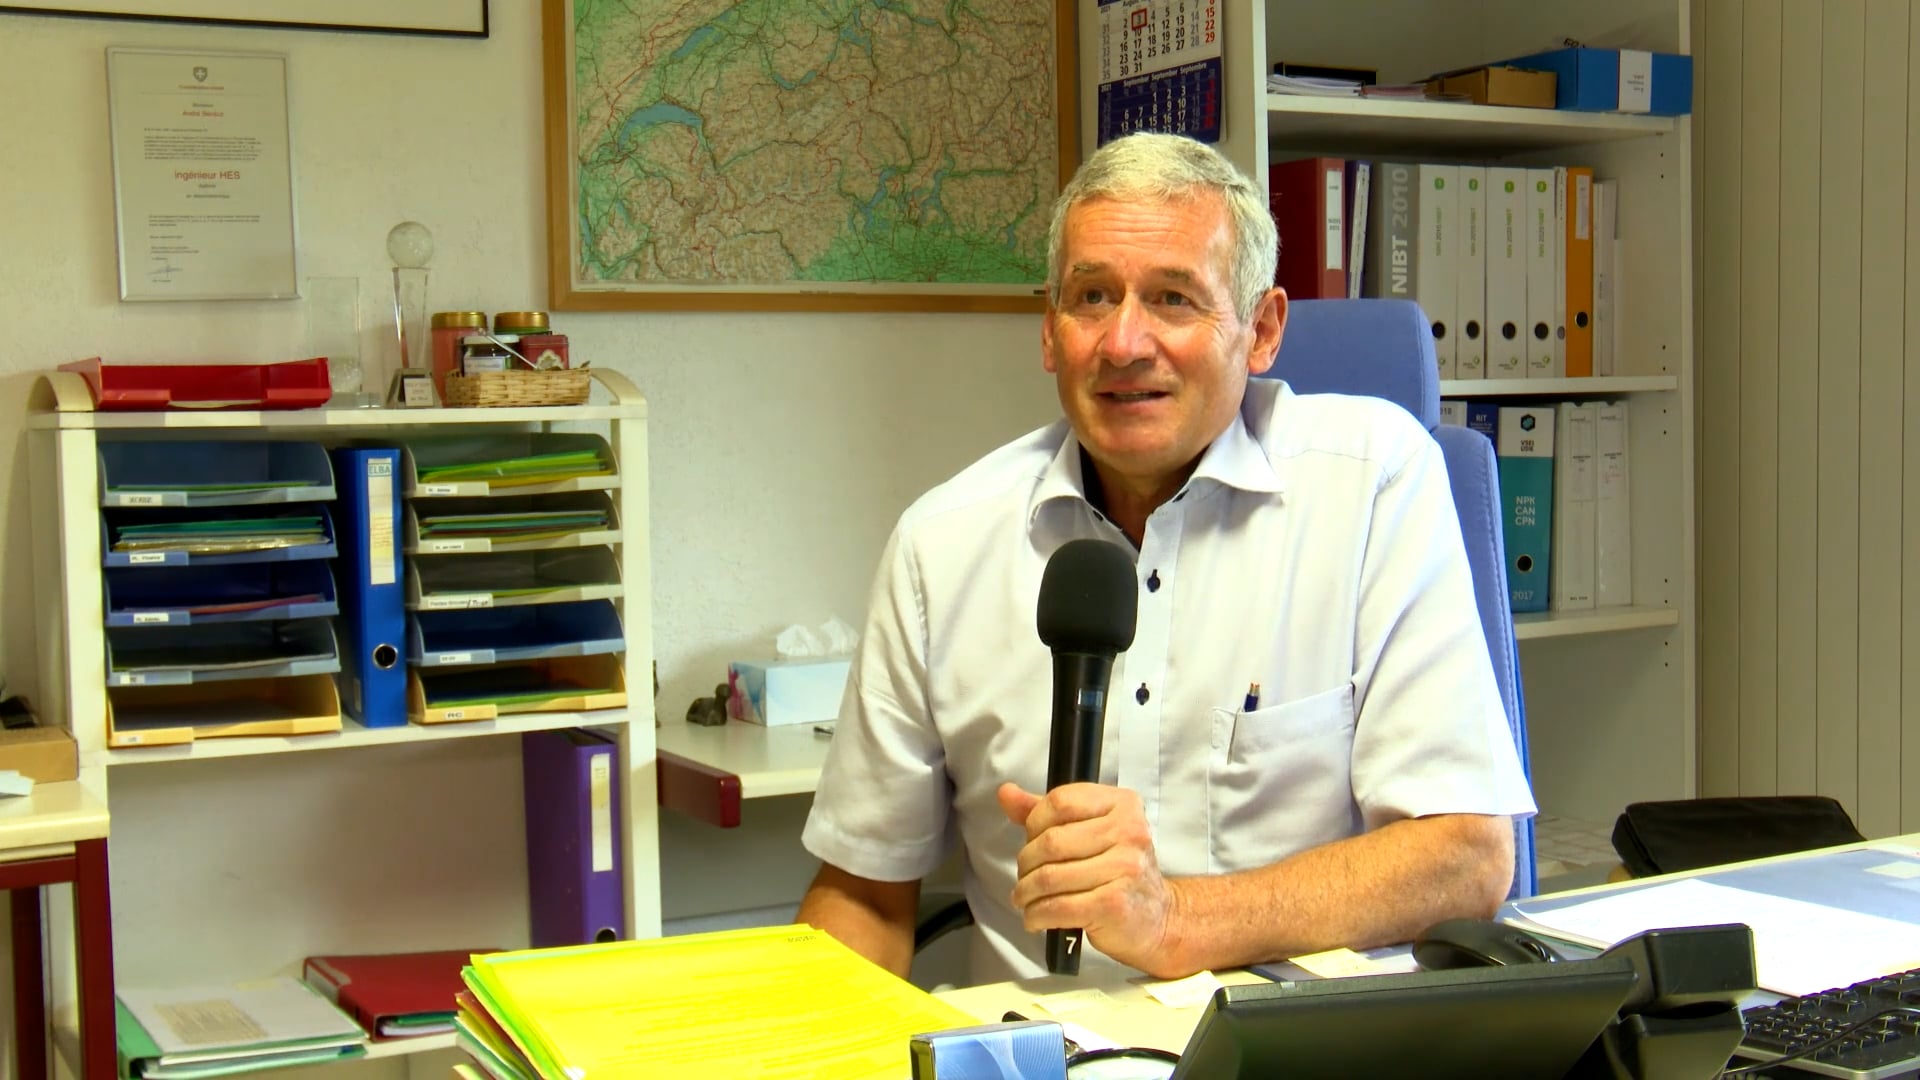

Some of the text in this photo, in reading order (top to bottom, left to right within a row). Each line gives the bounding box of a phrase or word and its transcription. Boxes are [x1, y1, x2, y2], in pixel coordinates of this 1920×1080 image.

[1123, 17, 1128, 28] 2
[1151, 9, 1156, 20] 4
[1165, 5, 1170, 17] 5
[1179, 2, 1185, 13] 6
[1123, 30, 1128, 41] 9
[1134, 27, 1141, 37] 10
[1148, 23, 1156, 34] 11
[1161, 18, 1170, 31] 12
[1175, 14, 1185, 26] 13
[1190, 10, 1200, 22] 14
[1205, 7, 1215, 18] 15
[1119, 41, 1128, 52] 16
[1133, 38, 1142, 49] 17
[1148, 34, 1156, 46] 18
[1161, 30, 1170, 42] 19
[1175, 27, 1185, 38] 20
[1190, 24, 1199, 35] 21
[1205, 19, 1215, 31] 22
[1119, 53, 1129, 64] 23
[1133, 49, 1142, 61] 24
[1147, 46, 1156, 58] 25
[1161, 43, 1170, 55] 26
[1175, 39, 1185, 51] 27
[1190, 35, 1200, 47] 28
[1205, 31, 1215, 43] 29
[1119, 65, 1129, 77] 30
[1134, 61, 1143, 73] 31
[1123, 76, 1150, 88] September
[1152, 68, 1178, 81] September
[1180, 62, 1207, 75] Septembre
[1152, 91, 1157, 103] 1
[1166, 88, 1172, 100] 2
[1180, 85, 1186, 96] 3
[1124, 109, 1130, 120] 6
[1138, 105, 1144, 118] 7
[1152, 103, 1158, 115] 8
[1166, 100, 1172, 112] 9
[1177, 97, 1187, 109] 10
[1120, 121, 1129, 133] 13
[1134, 117, 1143, 129] 14
[1148, 115, 1158, 128] 15
[1162, 112, 1172, 124] 16
[1177, 109, 1186, 121] 17
[1176, 121, 1186, 133] 24
[219, 170, 241, 180] HES
[1391, 167, 1408, 294] NIBT 2010
[368, 465, 391, 474] ELBA
[1515, 495, 1536, 505] NPK
[1514, 506, 1536, 516] CAN
[1514, 516, 1536, 526] CPN
[1512, 591, 1534, 600] 2017
[1065, 936, 1077, 954] 7
